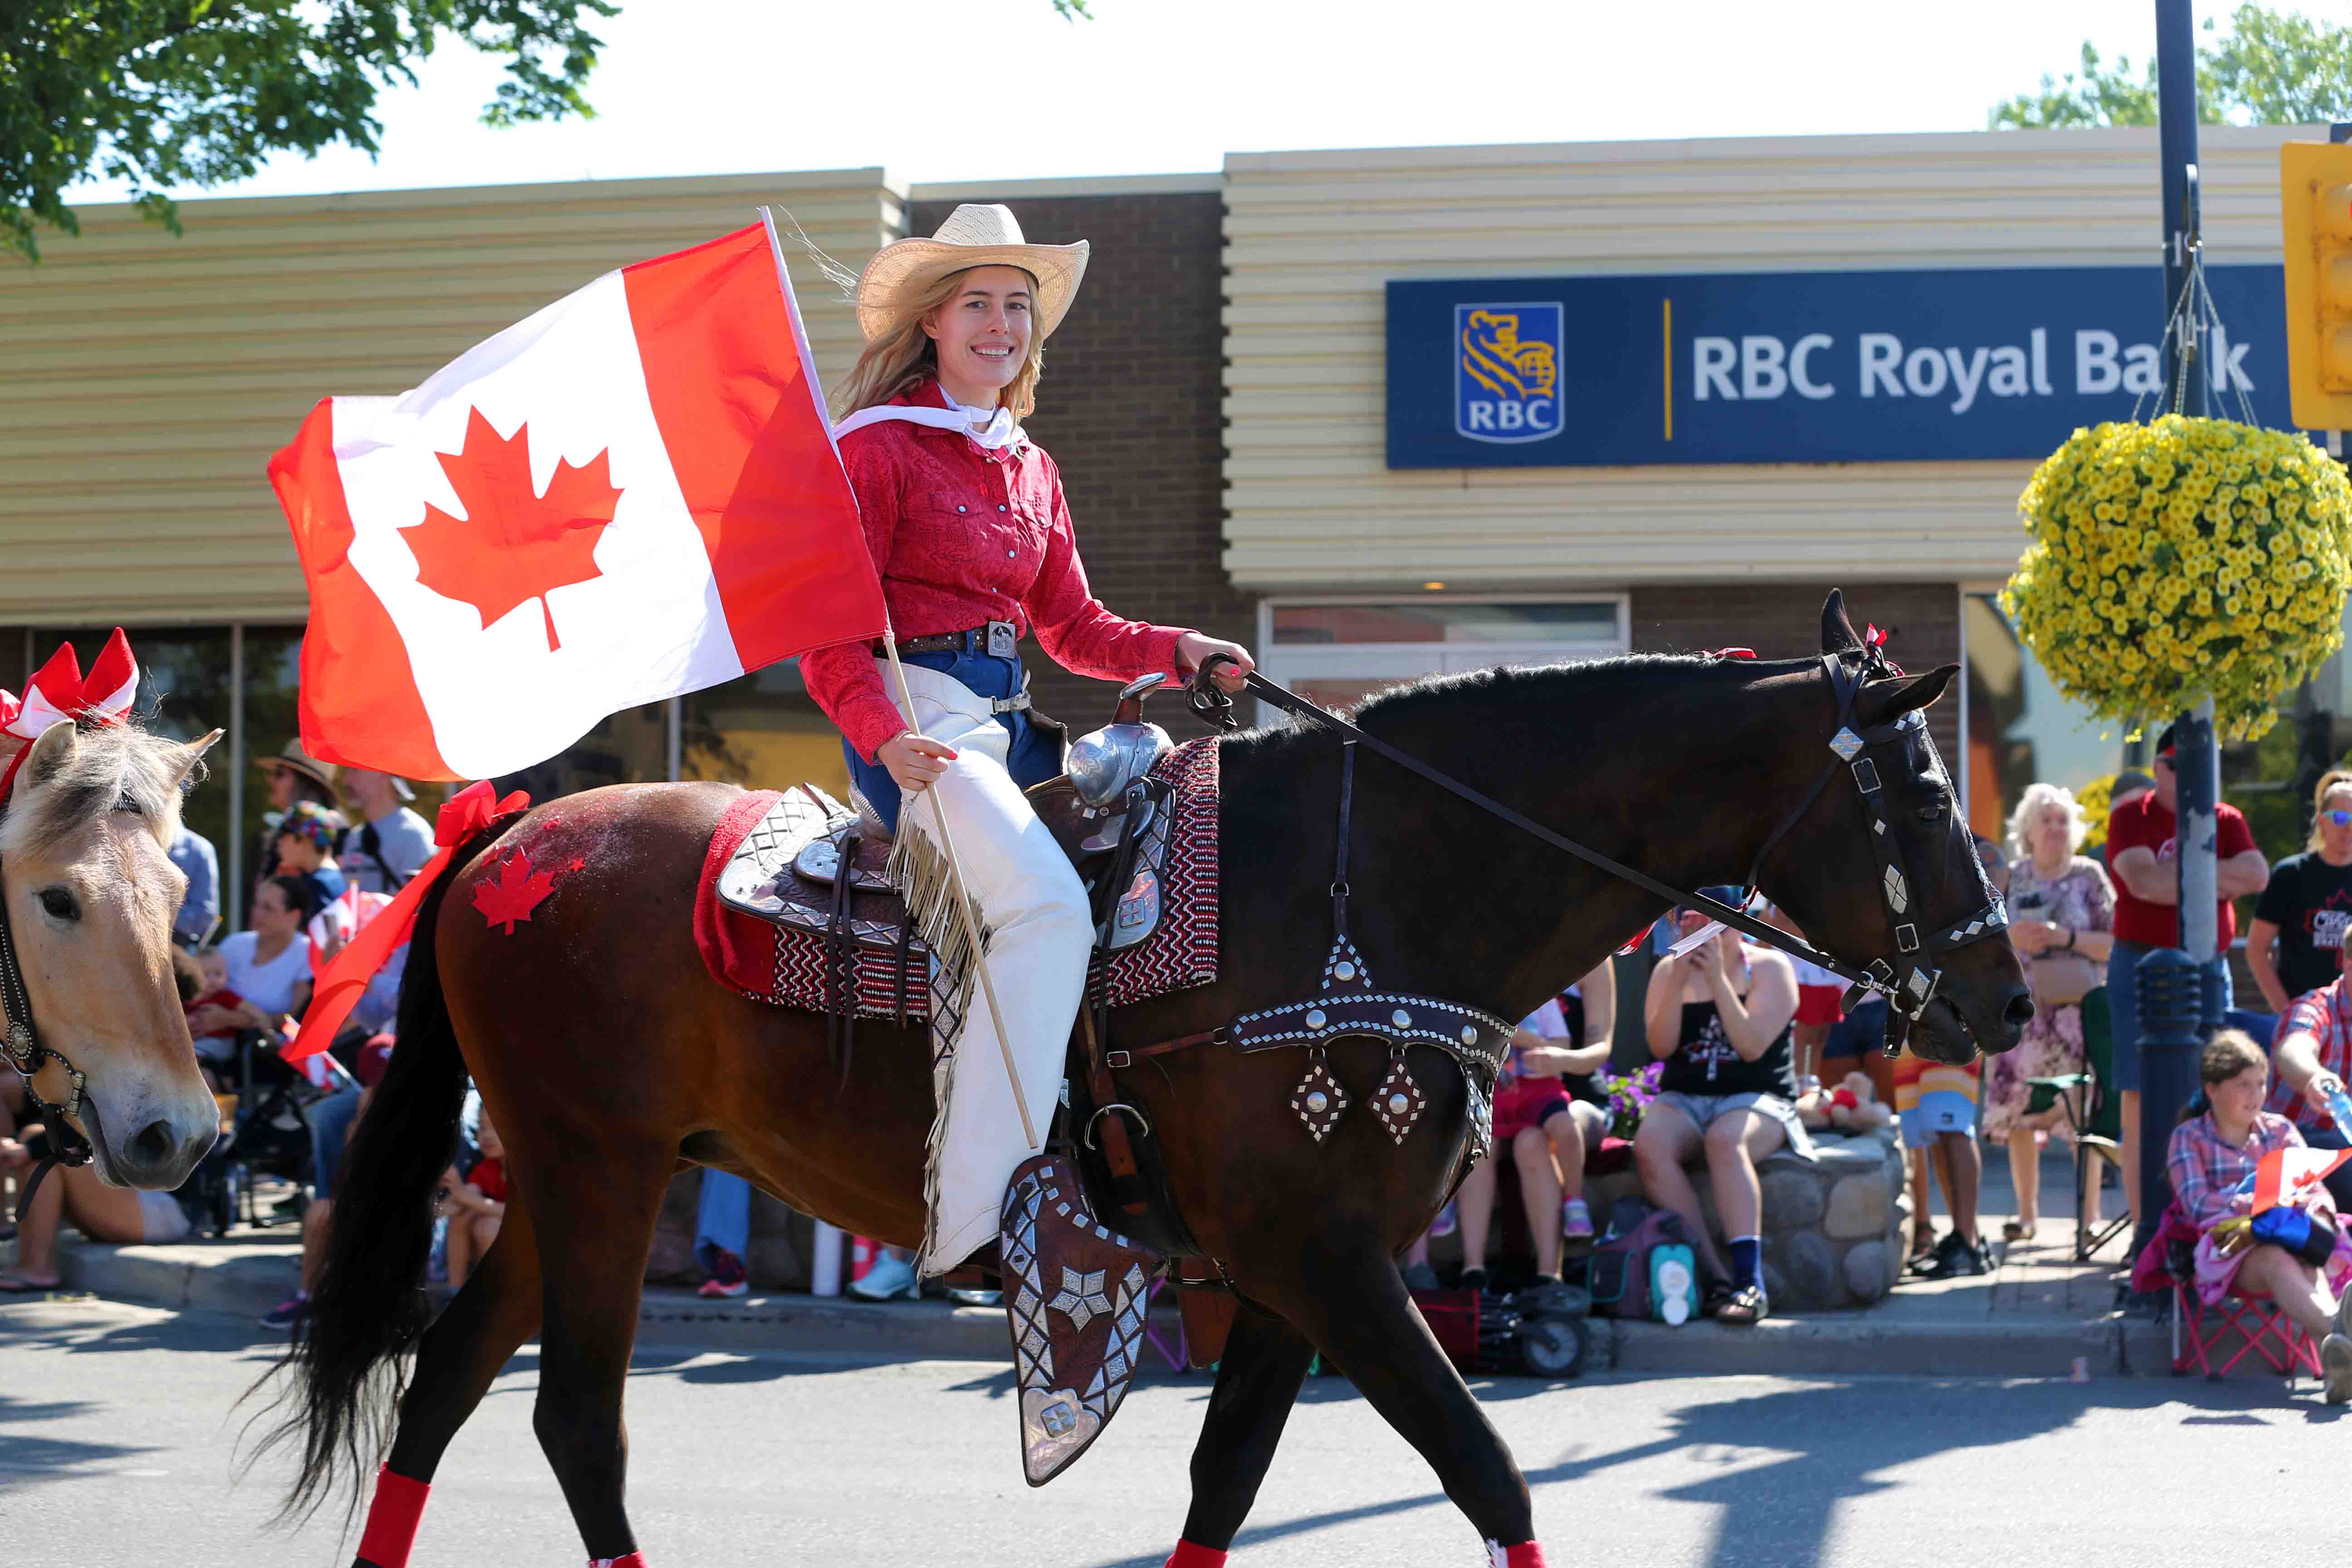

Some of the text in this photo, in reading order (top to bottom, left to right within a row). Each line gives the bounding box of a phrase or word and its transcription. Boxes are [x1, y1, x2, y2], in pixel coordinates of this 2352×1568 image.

[1694, 324, 2255, 415] RBC Royal Bak
[1468, 399, 1552, 430] RBC
